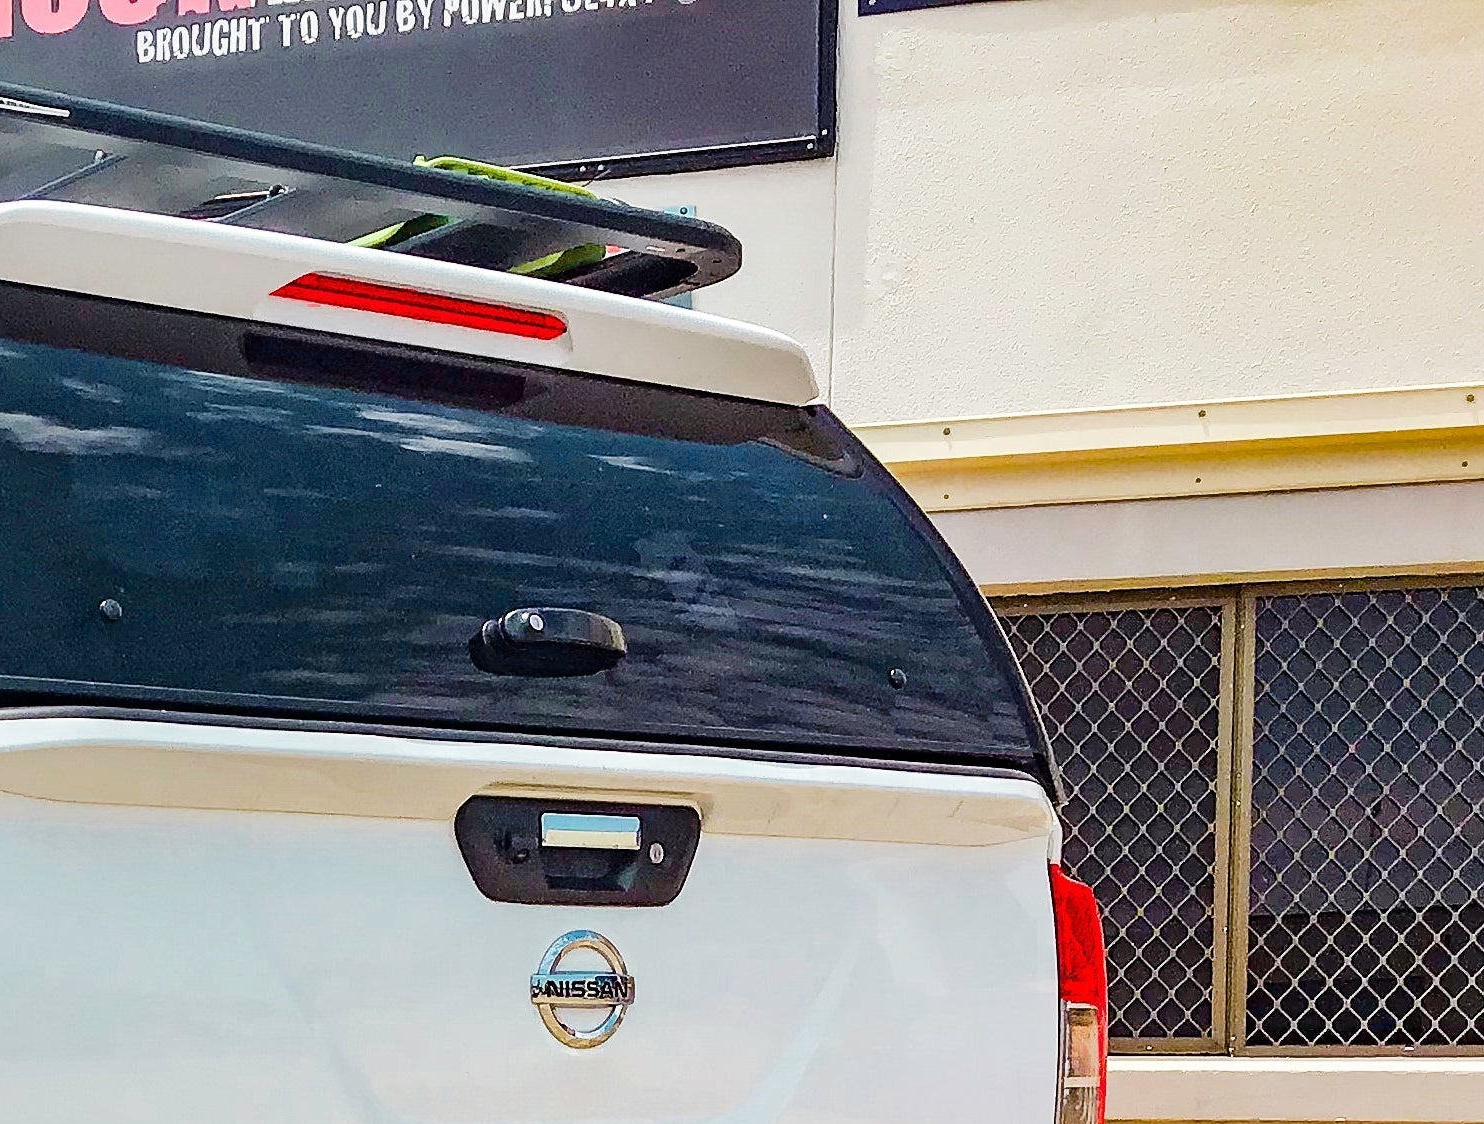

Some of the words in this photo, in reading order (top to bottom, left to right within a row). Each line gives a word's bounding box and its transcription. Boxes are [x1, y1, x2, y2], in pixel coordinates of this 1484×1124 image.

[136, 16, 269, 64] BROUGHT
[278, 10, 319, 48] TO
[328, 1, 387, 41] YOU
[396, 0, 434, 33] BY
[546, 980, 629, 999] NISSAN
